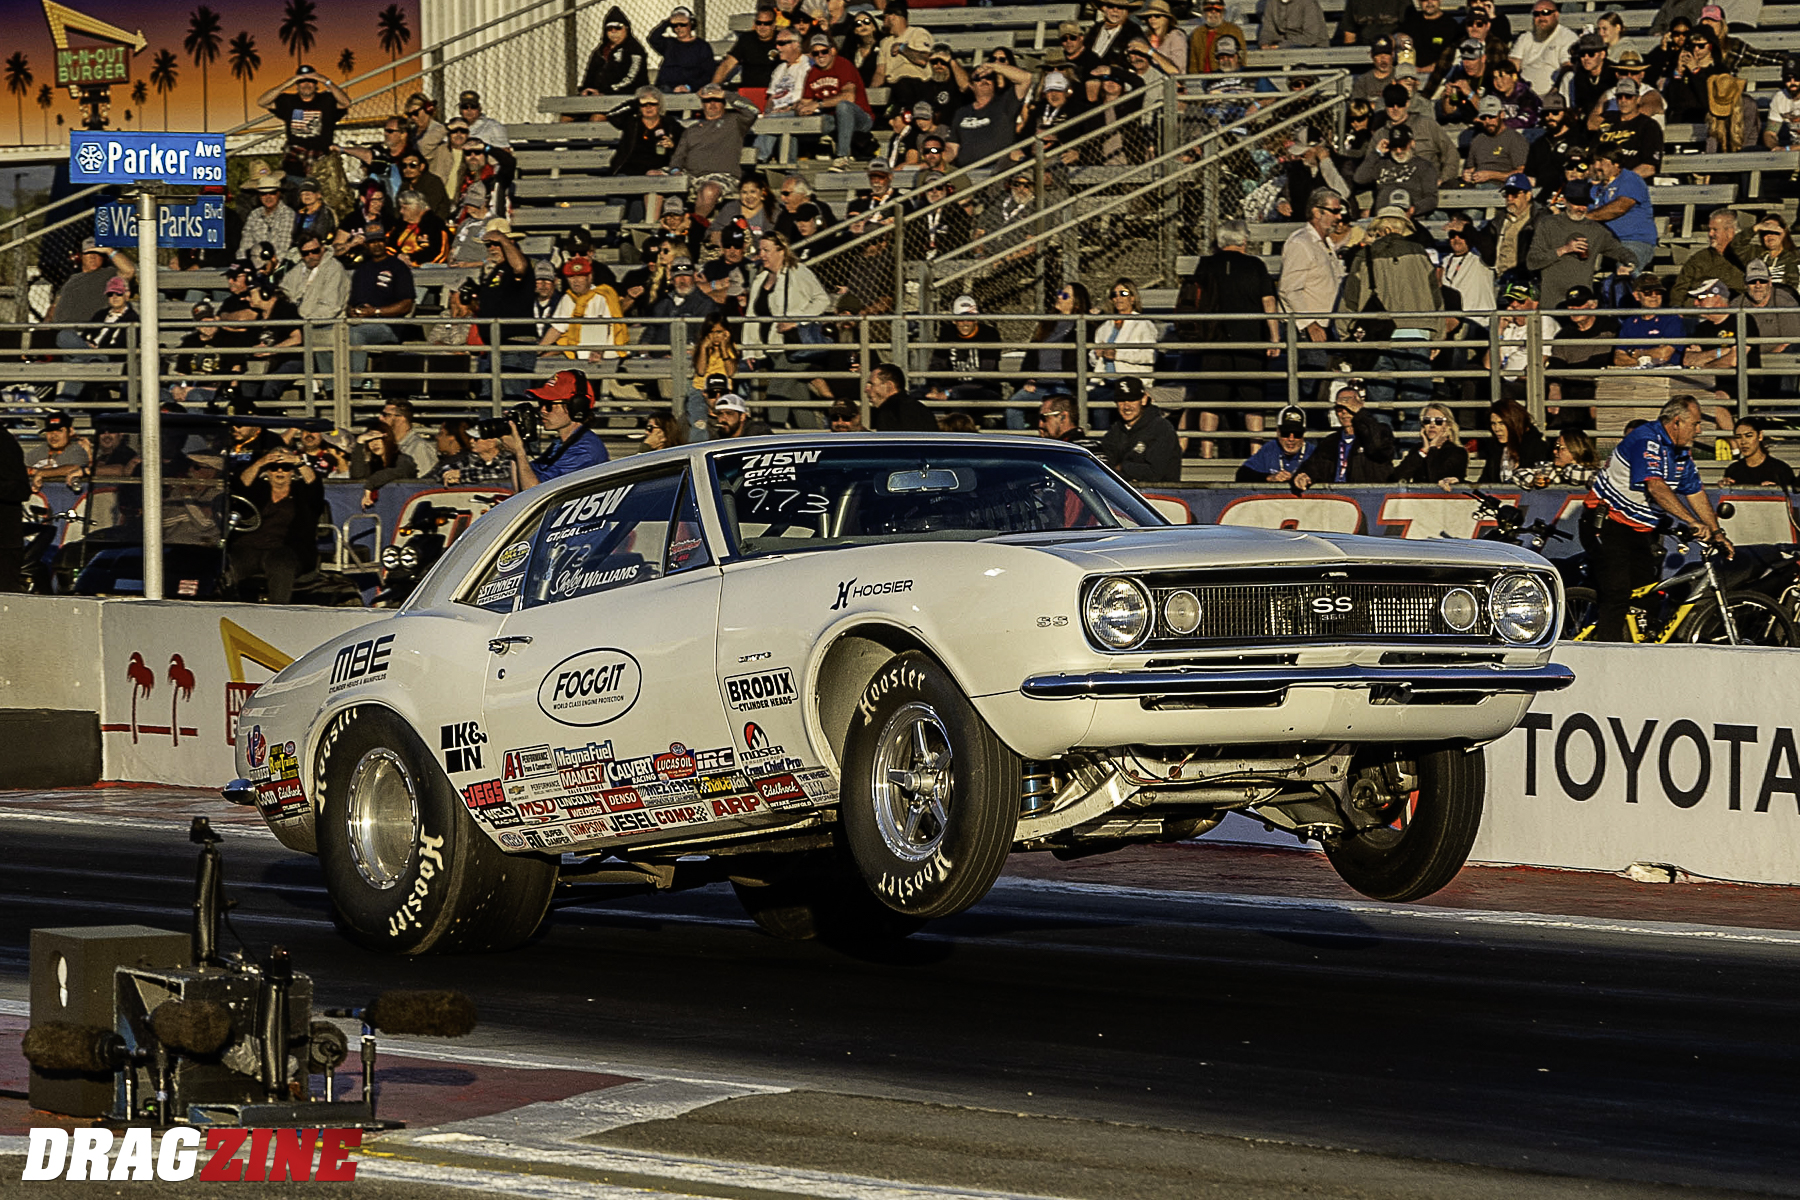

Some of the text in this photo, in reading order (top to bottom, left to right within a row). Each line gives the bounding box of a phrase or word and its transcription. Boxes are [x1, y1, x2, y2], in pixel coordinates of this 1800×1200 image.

[58, 46, 125, 64] IN-N-OUT
[58, 63, 127, 83] BURGER
[107, 141, 221, 175] Parker Ave
[192, 167, 221, 181] 1950
[160, 206, 203, 237] Parks
[204, 203, 223, 220] Blvd
[742, 450, 822, 470] 715W
[744, 466, 796, 478] GT/GA
[550, 484, 634, 529] 715W
[581, 564, 639, 589] WILLIAMS
[852, 579, 914, 598] HOOSIER
[1312, 596, 1353, 613] SS
[1036, 615, 1069, 628] SS
[330, 633, 396, 685] MBE
[553, 663, 626, 701] FOGGIT
[727, 672, 794, 702] BRODIX
[553, 695, 624, 710] WORLD CLASS ENGINE PROTECTION
[858, 660, 926, 726] Hoosier
[738, 695, 793, 712] CYLINDER HEADS
[555, 742, 613, 768] MagnaFuel
[739, 745, 785, 761] MOSER
[607, 757, 654, 782] CALVERT
[656, 757, 693, 772] LUCAS OIL
[1514, 712, 1800, 816] TOYOTA
[560, 766, 602, 787] MANLEY
[631, 773, 657, 784] RACING
[465, 780, 505, 808] JEGS
[762, 781, 799, 798] Edelbrock
[517, 799, 556, 818] MSD
[557, 794, 594, 807] LINCOLN
[607, 793, 637, 806] DENSO
[711, 795, 761, 817] ARP
[483, 806, 516, 819] WELD
[571, 806, 603, 818] WELDERS
[655, 807, 696, 825] COMP
[569, 820, 609, 836] SIMPSON
[609, 812, 659, 832] JESEL
[388, 824, 444, 937] Hoosier
